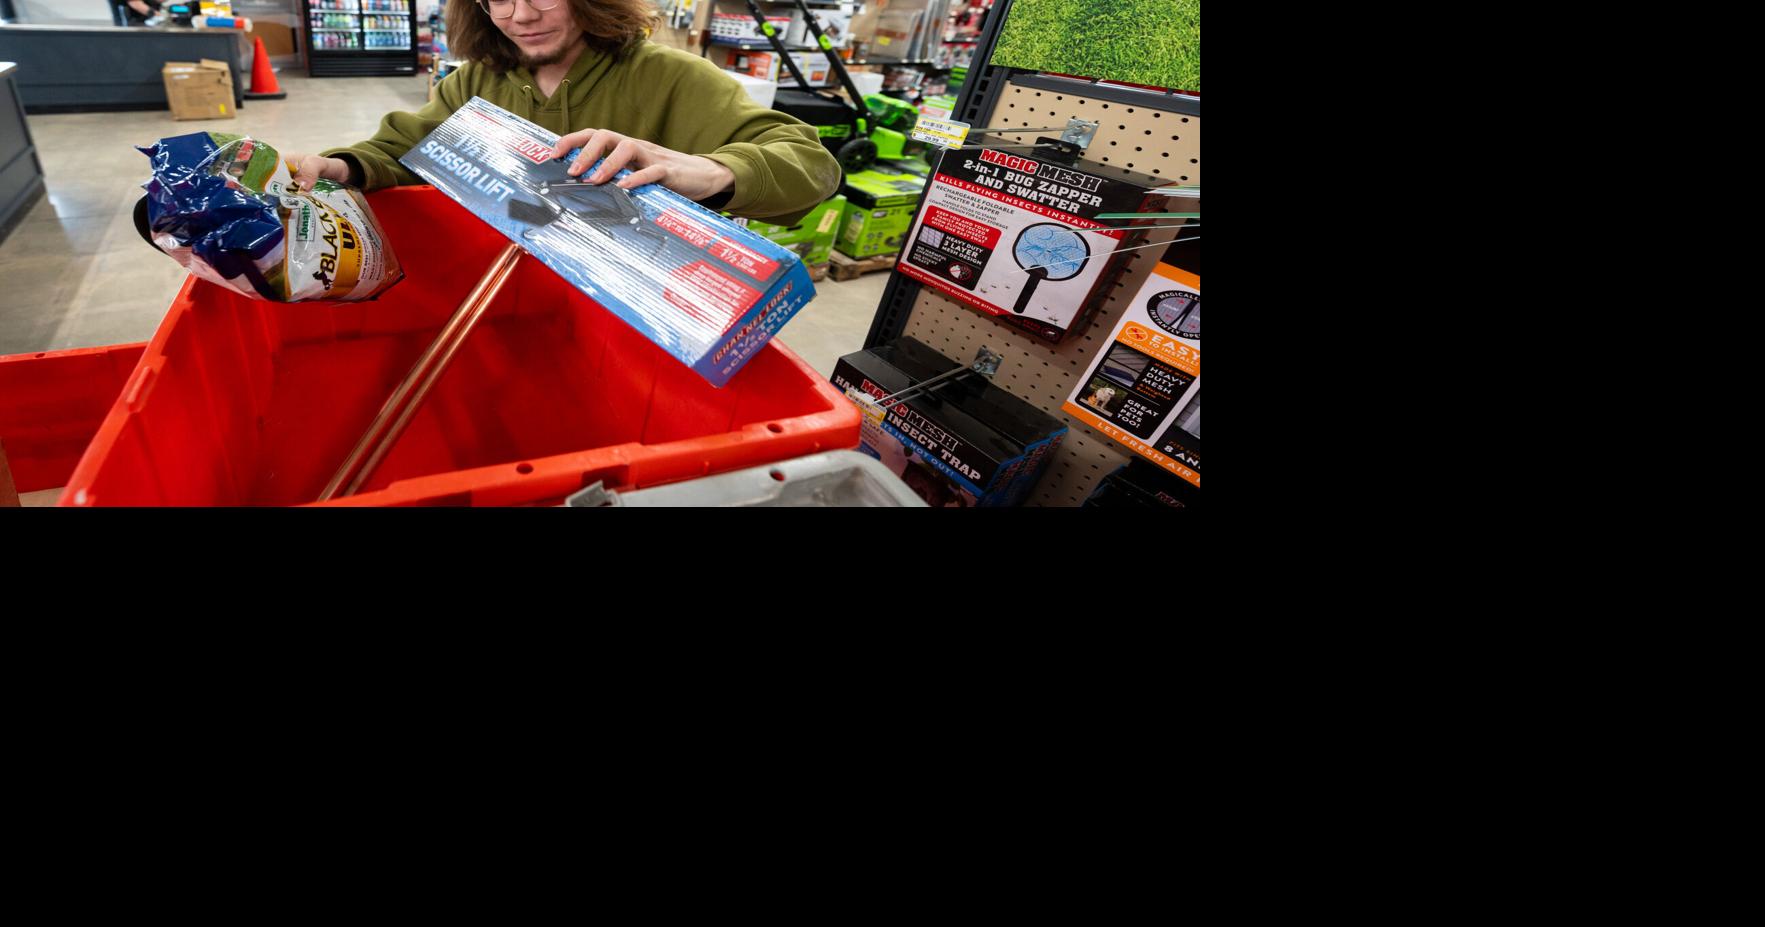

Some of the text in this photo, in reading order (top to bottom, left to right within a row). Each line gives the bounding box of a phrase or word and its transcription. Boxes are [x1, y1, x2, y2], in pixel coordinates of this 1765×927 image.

[420, 140, 482, 182] SCISSOR
[477, 173, 516, 202] LIFT
[979, 149, 1040, 174] MAGIC
[939, 175, 964, 188] KILLS
[966, 184, 999, 199] FLYING
[1001, 195, 1044, 214] INSECTS
[963, 160, 1104, 208] 2-in-1 BUG ZAPPER
[975, 175, 1081, 214] AND SWATTER
[936, 184, 1014, 214] RECHARGEABLE FOLDABLE
[945, 193, 970, 205] SWATTER
[976, 204, 1000, 216] ZAPPER
[974, 224, 990, 232] YOUR
[319, 213, 338, 273] BLACK
[925, 249, 946, 260] HARMFUL
[946, 235, 984, 254] HEAVY DUTY
[950, 242, 978, 258] LAYER
[941, 246, 982, 265] MESH DESIGN
[951, 289, 972, 301] BUZZING
[981, 303, 999, 314] BITING
[1158, 291, 1200, 302] MAGICALL
[756, 300, 789, 331] TON
[1150, 309, 1180, 334] INSTANTLY
[722, 294, 803, 375] SCISSOR LIFT
[1134, 342, 1155, 354] TOOLS
[1152, 335, 1200, 361] EASY
[1142, 378, 1172, 394] MESH
[1146, 372, 1174, 386] DUTY
[1150, 367, 1186, 385] HEAVY
[1120, 408, 1142, 422] PETS
[1124, 404, 1144, 416] FOR
[1127, 400, 1159, 416] GREAT
[1117, 413, 1140, 428] TOO!
[887, 412, 938, 450] INSECT
[941, 449, 981, 480] TRAP
[1097, 422, 1192, 477] LET FRESH AIR
[910, 442, 928, 457] NOT
[931, 458, 954, 477] OUT!
[1176, 453, 1200, 470] AN
